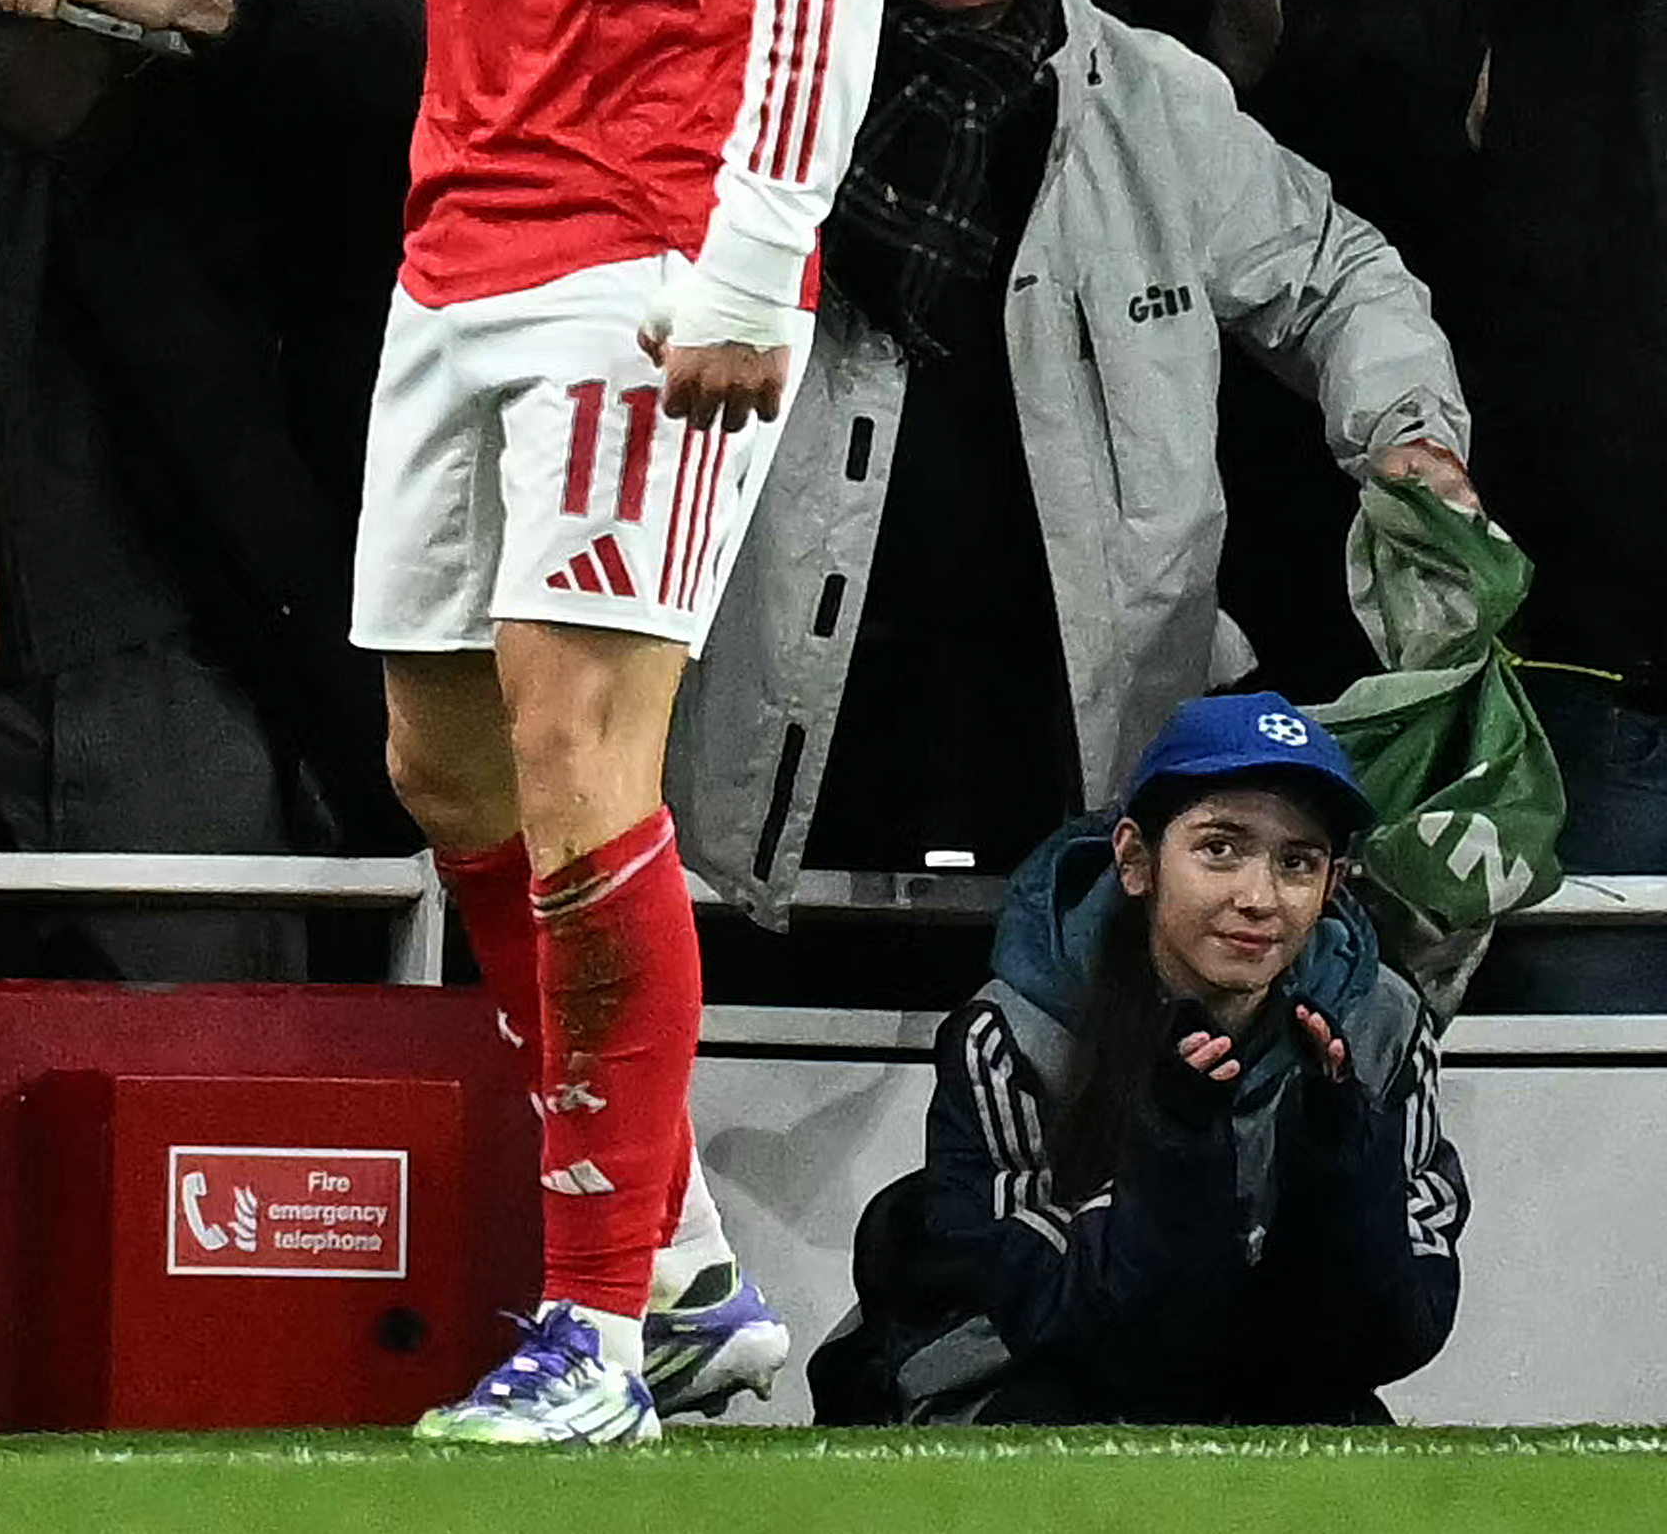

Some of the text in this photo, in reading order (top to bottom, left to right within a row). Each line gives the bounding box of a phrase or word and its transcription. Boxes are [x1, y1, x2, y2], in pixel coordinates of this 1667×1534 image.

[1128, 285, 1193, 323] Gill
[561, 378, 660, 525] 11
[307, 1171, 351, 1193] Fire
[267, 1202, 388, 1226] emergency
[274, 1229, 383, 1254] telephone
